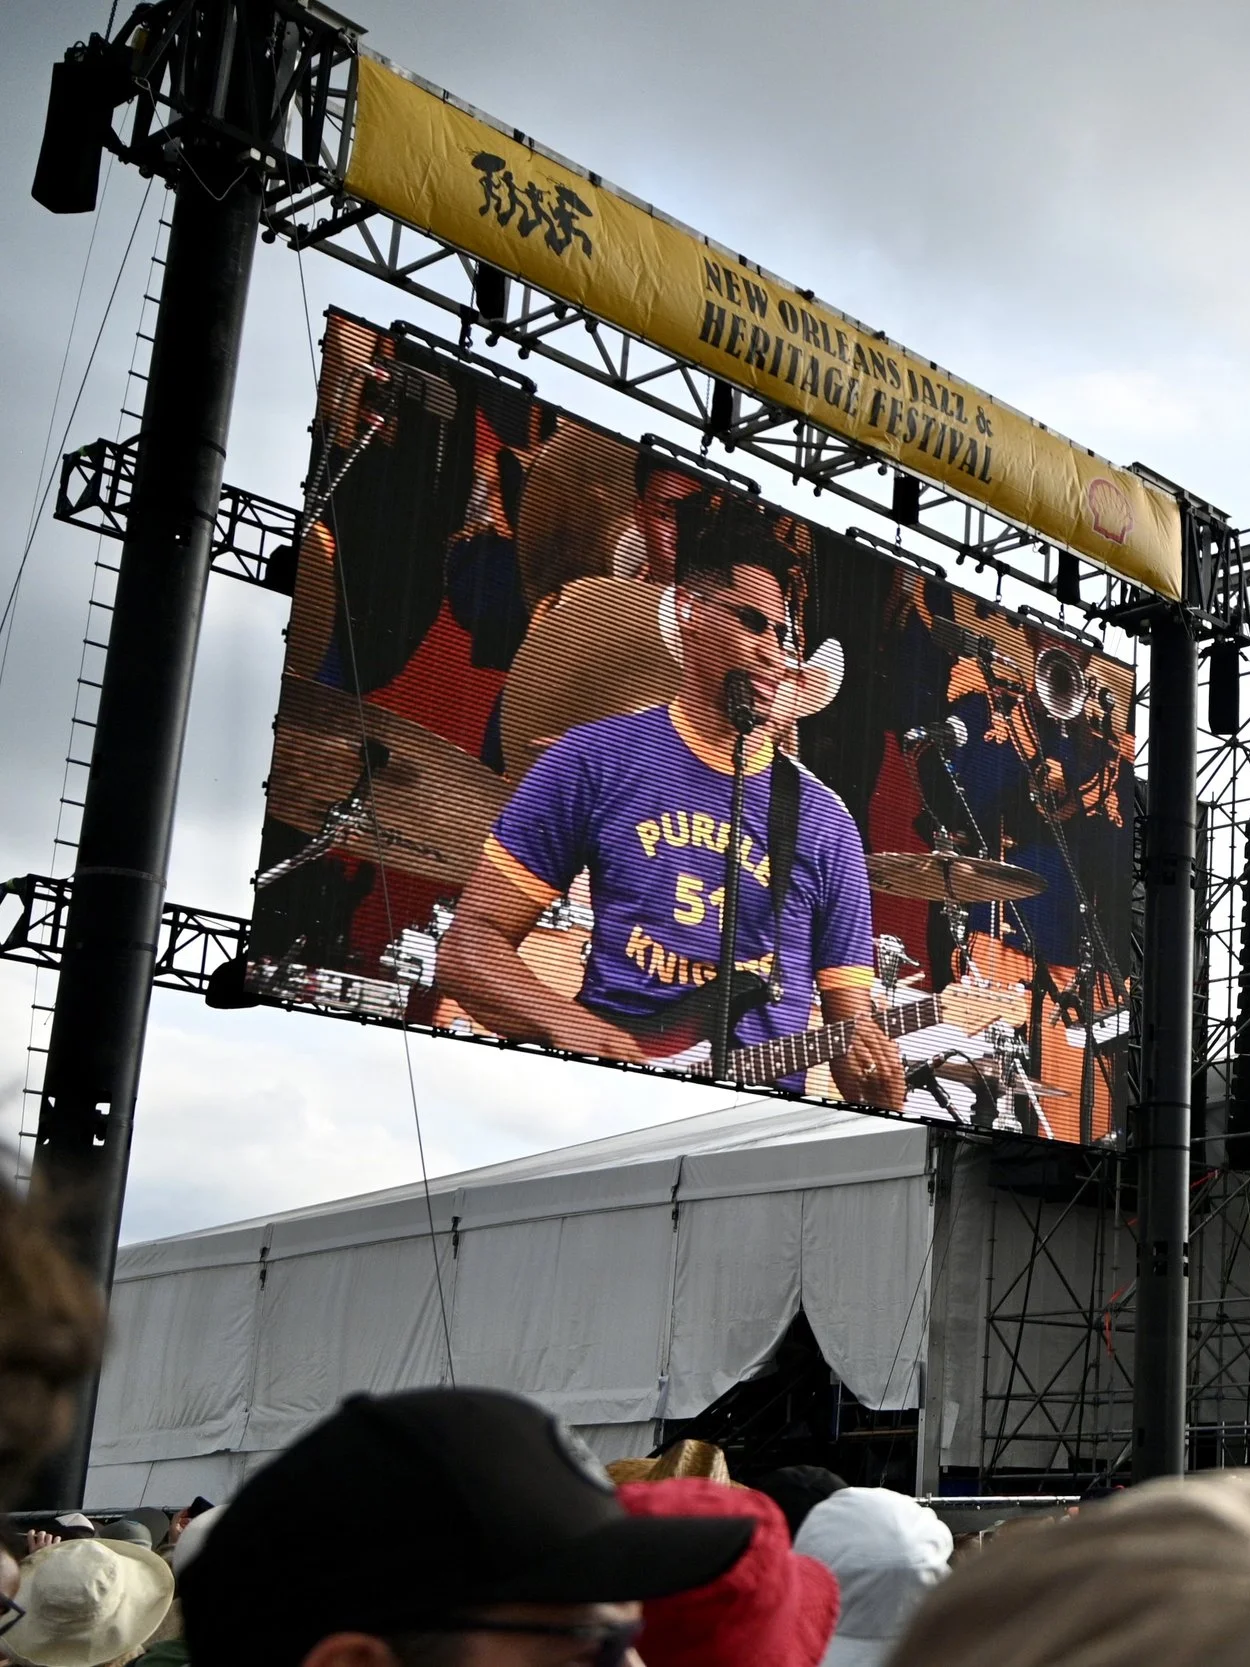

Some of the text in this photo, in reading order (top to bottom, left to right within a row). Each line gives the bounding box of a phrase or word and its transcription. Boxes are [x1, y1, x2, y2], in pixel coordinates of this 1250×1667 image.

[699, 300, 993, 485] HERITAGE FESTIVAL
[703, 256, 993, 438] NEW ORLEANS JAZZ &
